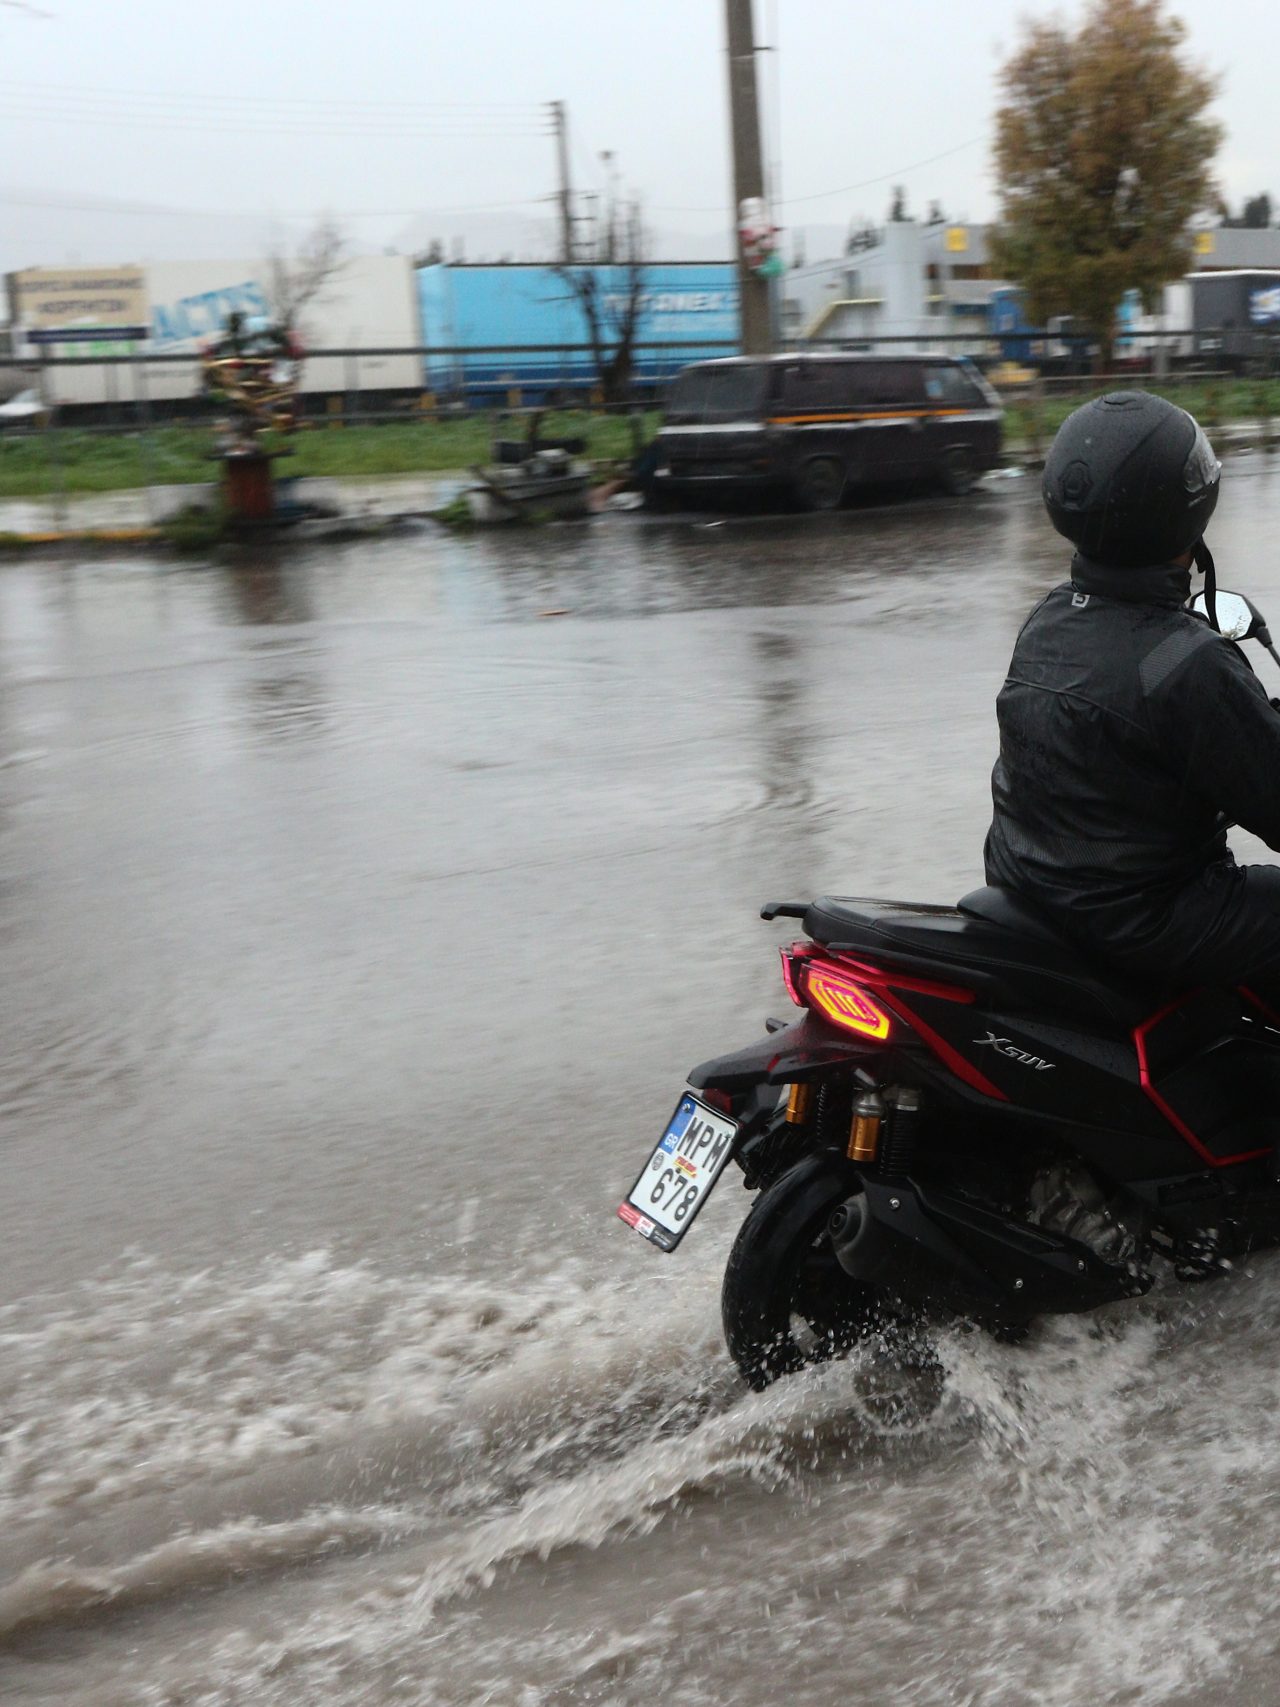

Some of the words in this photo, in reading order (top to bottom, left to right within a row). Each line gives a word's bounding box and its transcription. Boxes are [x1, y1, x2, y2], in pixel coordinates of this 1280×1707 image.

[664, 1132, 679, 1150] GR
[677, 1117, 731, 1173] MPM
[650, 1168, 699, 1221] 678
